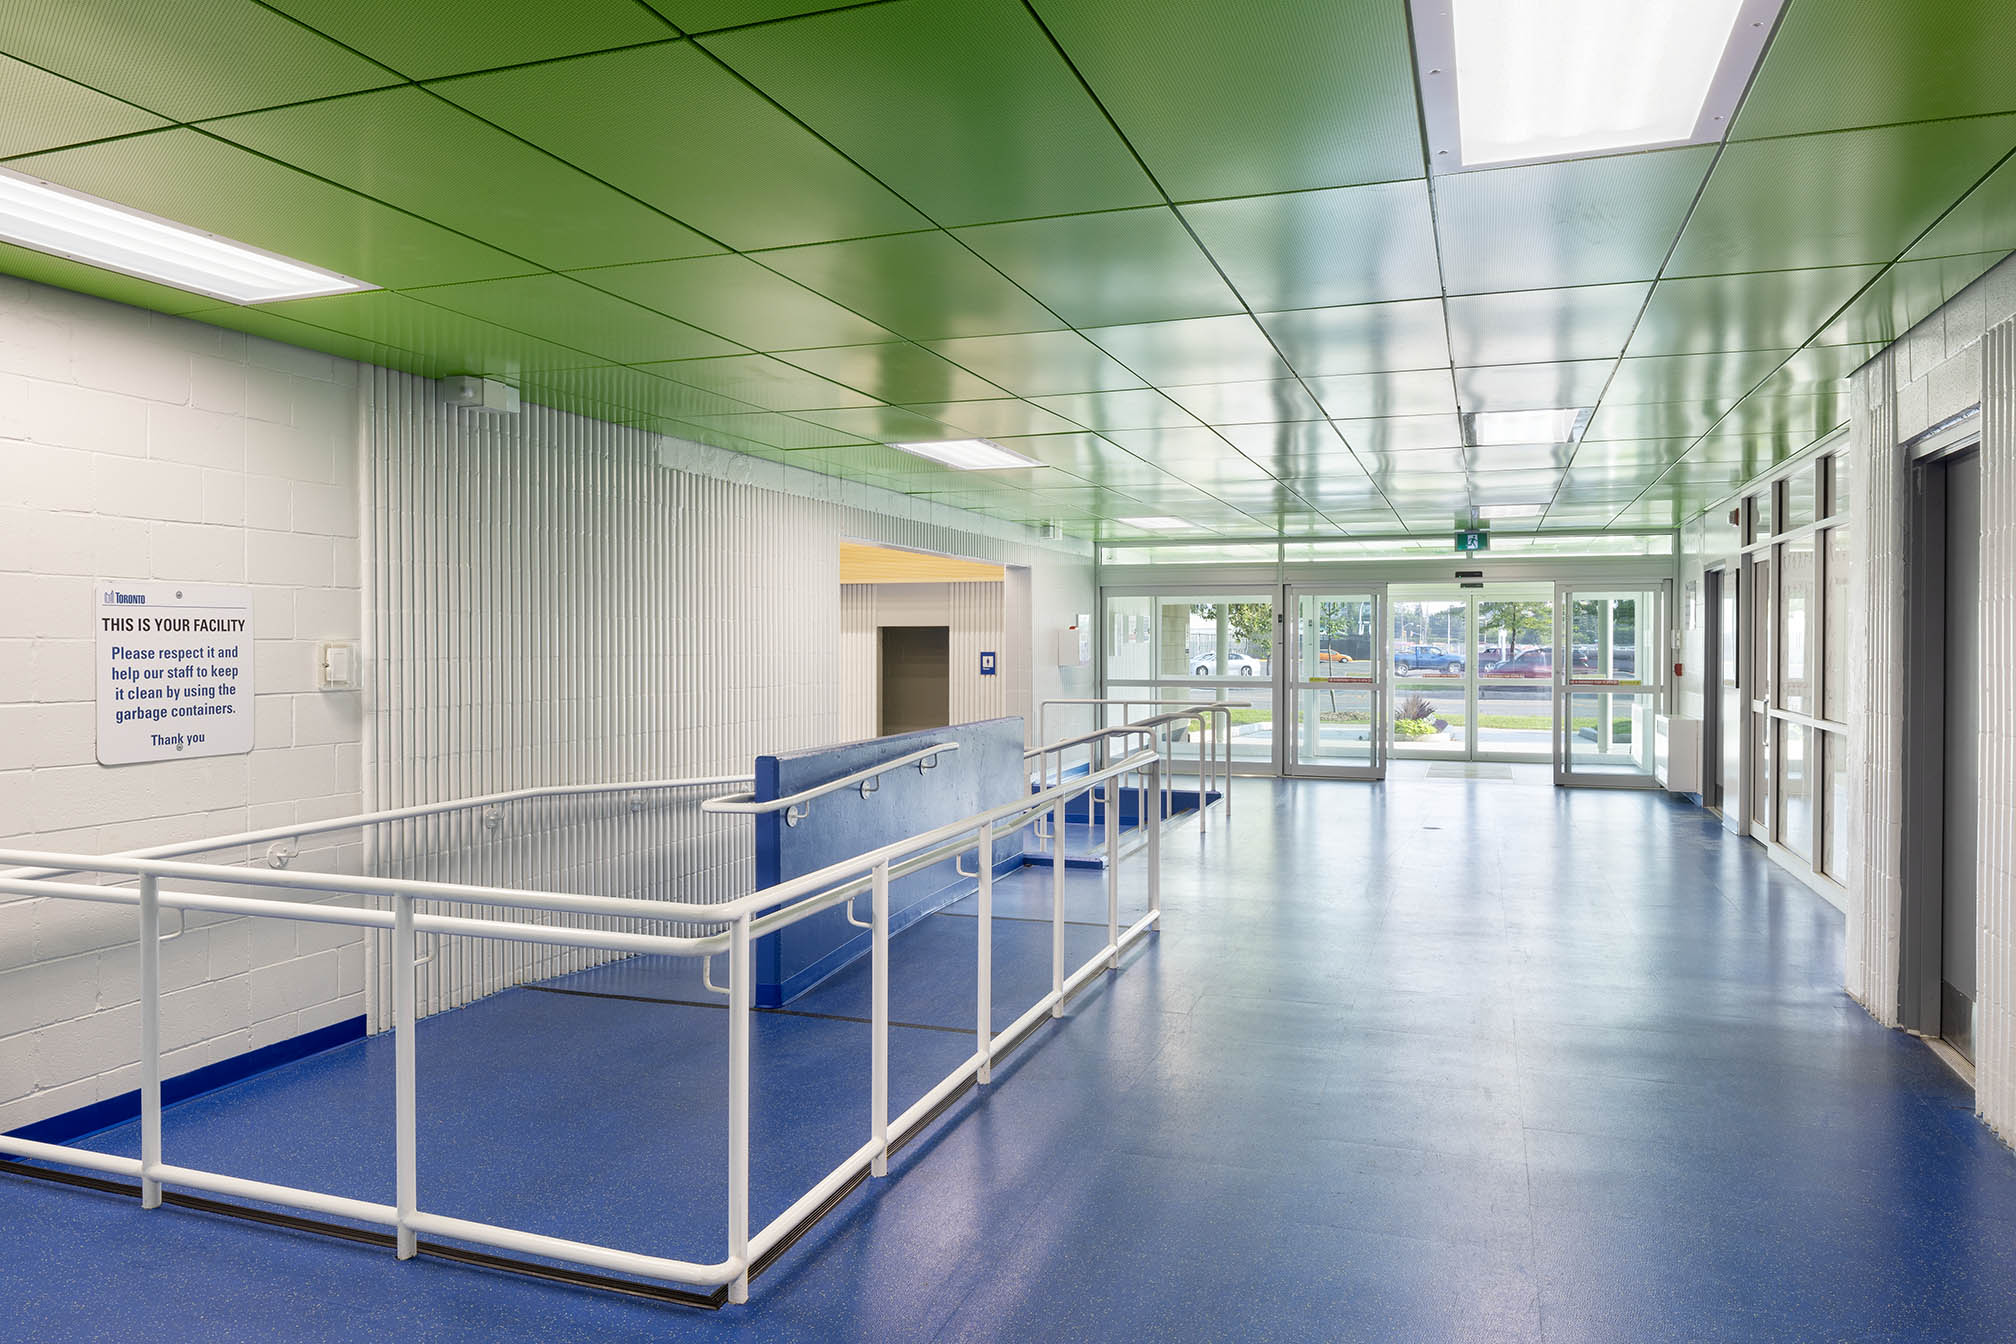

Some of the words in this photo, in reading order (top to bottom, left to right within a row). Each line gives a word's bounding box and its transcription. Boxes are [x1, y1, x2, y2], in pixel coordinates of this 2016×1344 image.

[115, 592, 145, 604] TORONTO
[102, 618, 134, 632] THIS
[139, 618, 150, 632] IS
[155, 619, 190, 632] YOUR
[194, 620, 245, 632] FACILITY
[112, 647, 155, 660] Please
[159, 647, 204, 661] respect
[207, 646, 215, 658] it
[218, 646, 238, 658] and
[112, 667, 139, 682] help
[144, 669, 164, 679] our
[168, 666, 194, 678] staff
[196, 667, 207, 677] to
[211, 665, 238, 679] keep
[115, 687, 124, 700] it
[128, 686, 162, 699] clean
[167, 686, 180, 700] by
[184, 685, 215, 698] using
[219, 684, 236, 695] the
[116, 707, 167, 724] garbage
[171, 703, 235, 717] containers.
[151, 733, 183, 746] Thank
[187, 734, 205, 745] you
